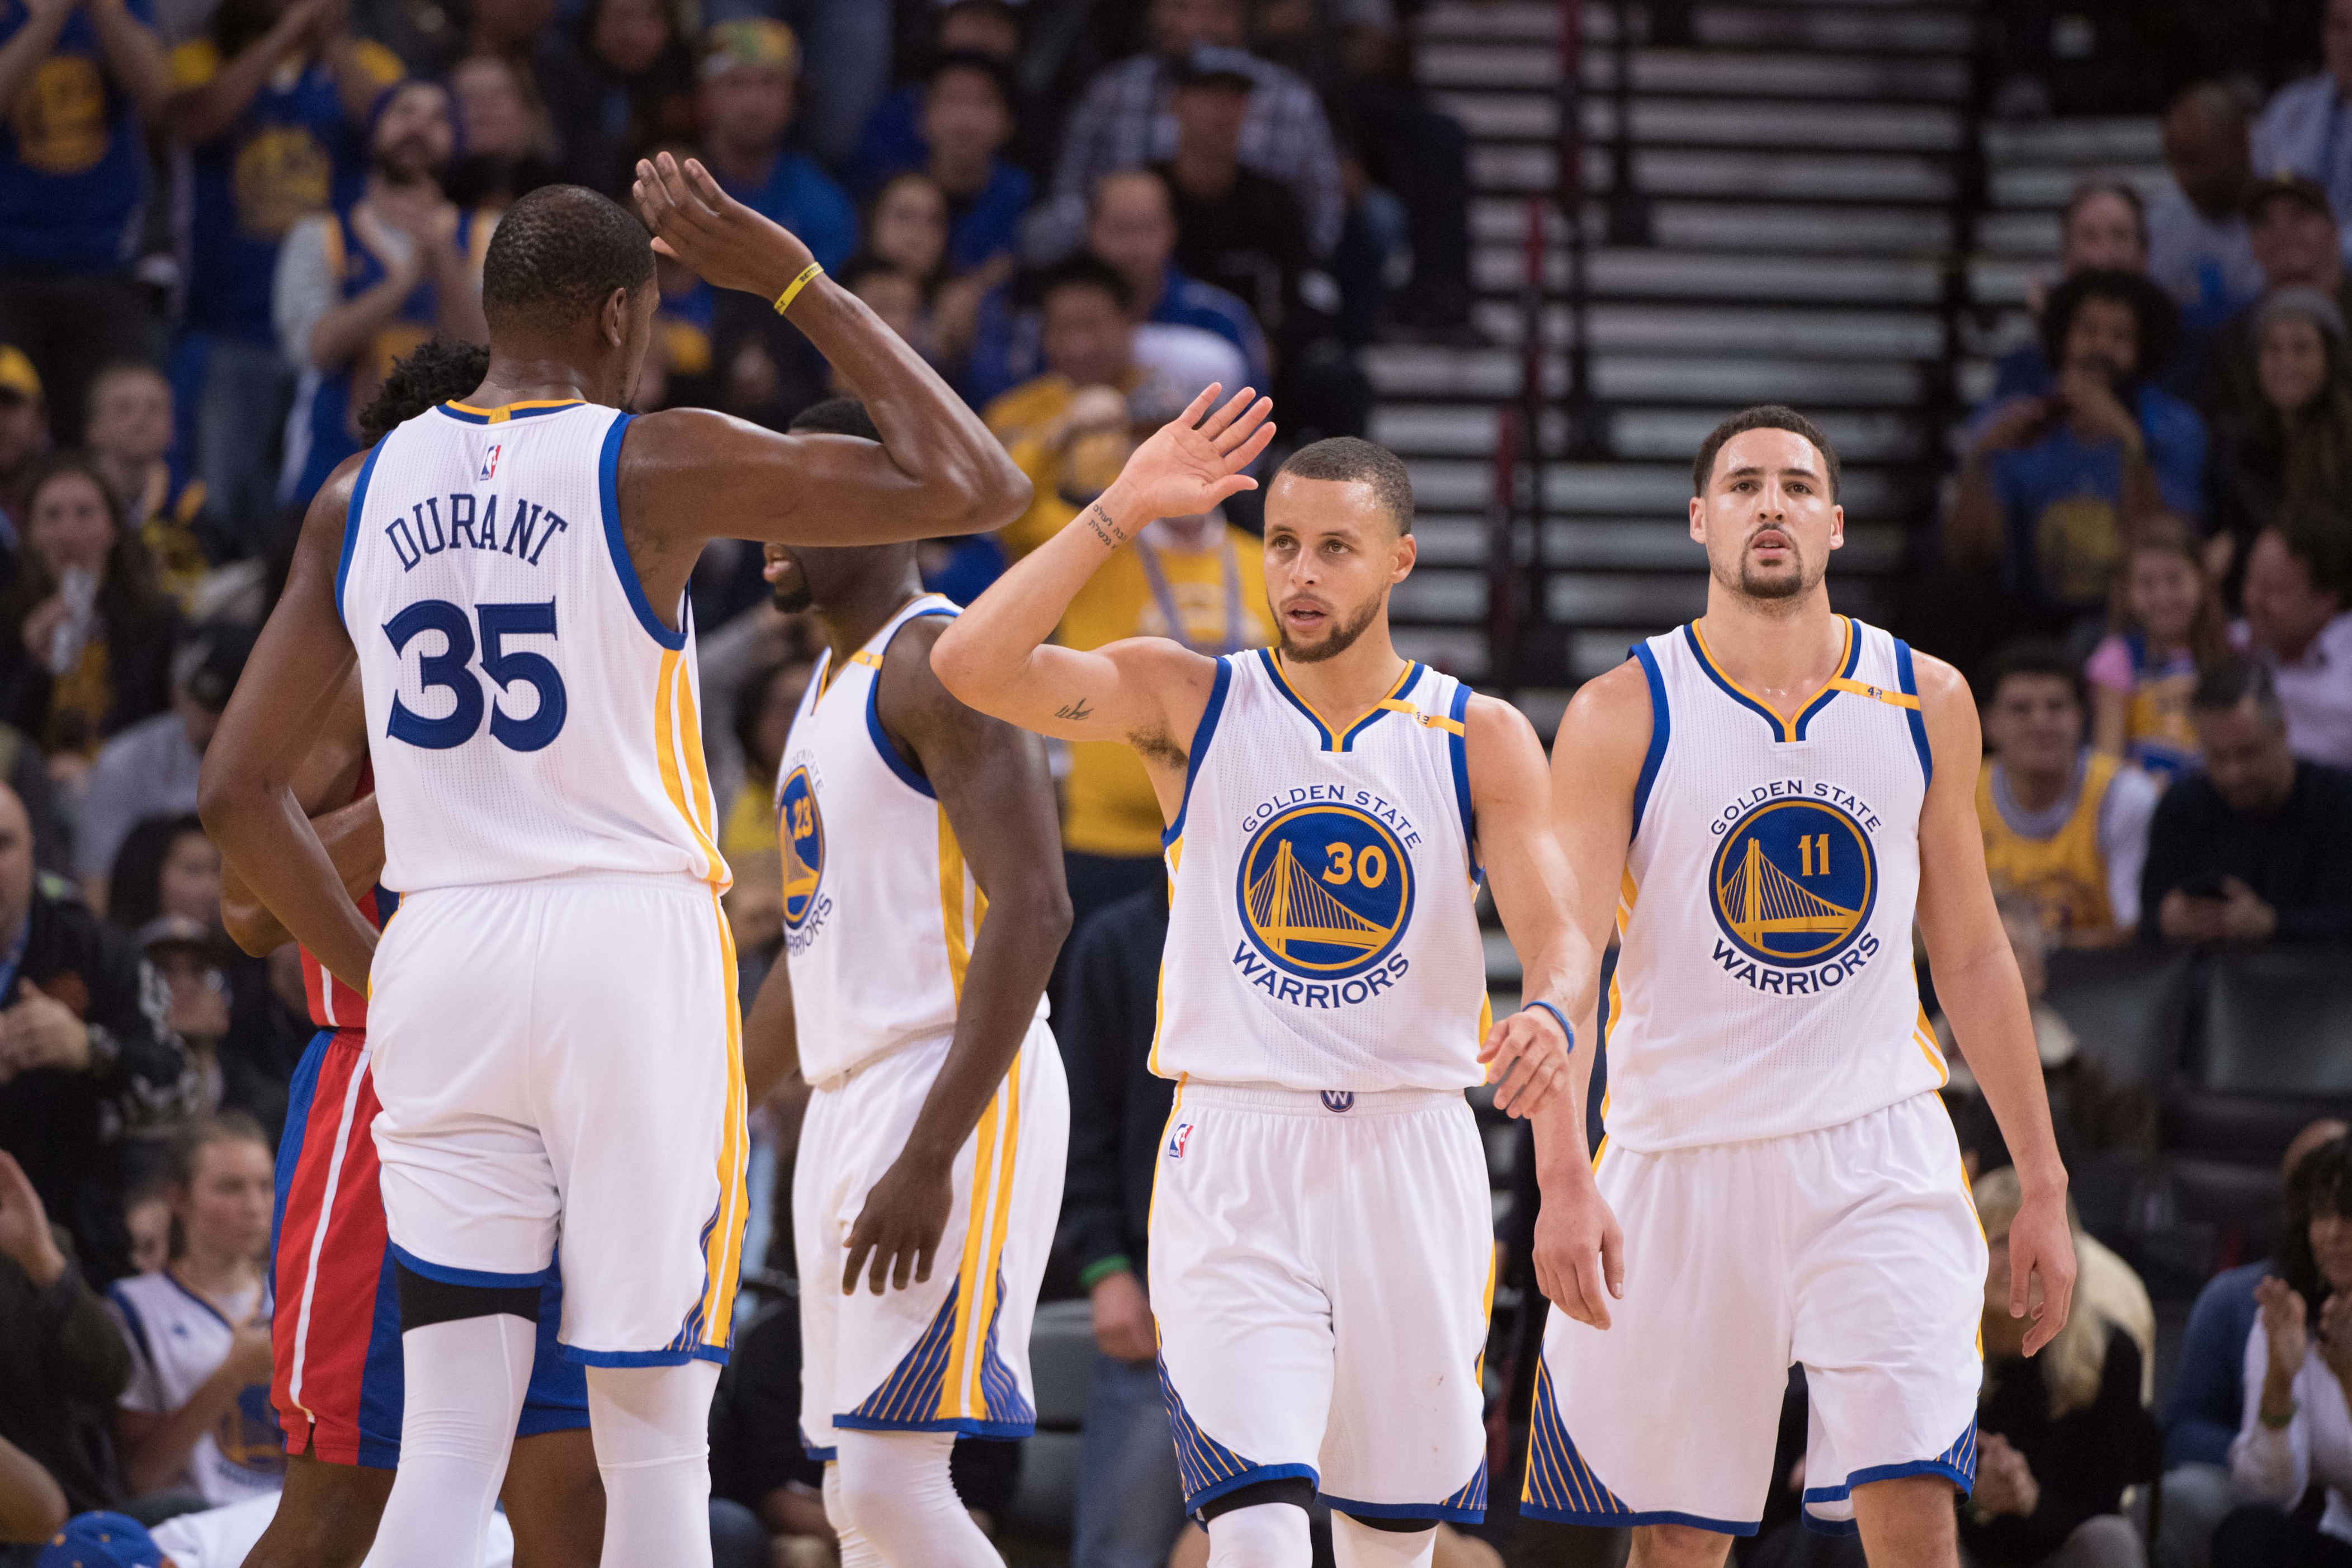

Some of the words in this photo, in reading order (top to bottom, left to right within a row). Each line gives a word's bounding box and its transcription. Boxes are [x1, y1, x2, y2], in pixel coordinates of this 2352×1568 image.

[385, 494, 568, 573] DURANT
[381, 595, 568, 752] 35
[792, 795, 814, 841] 23
[1242, 785, 1345, 833] GOLDEN
[1355, 791, 1422, 850] STATE
[1711, 780, 1803, 835] GOLDEN
[1813, 782, 1882, 833] STATE
[1322, 842, 1387, 889] 30
[1798, 833, 1830, 876] 11
[1231, 939, 1410, 1009] WARRIORS
[1712, 932, 1880, 995] WARRIORS
[1326, 1090, 1350, 1104] W
